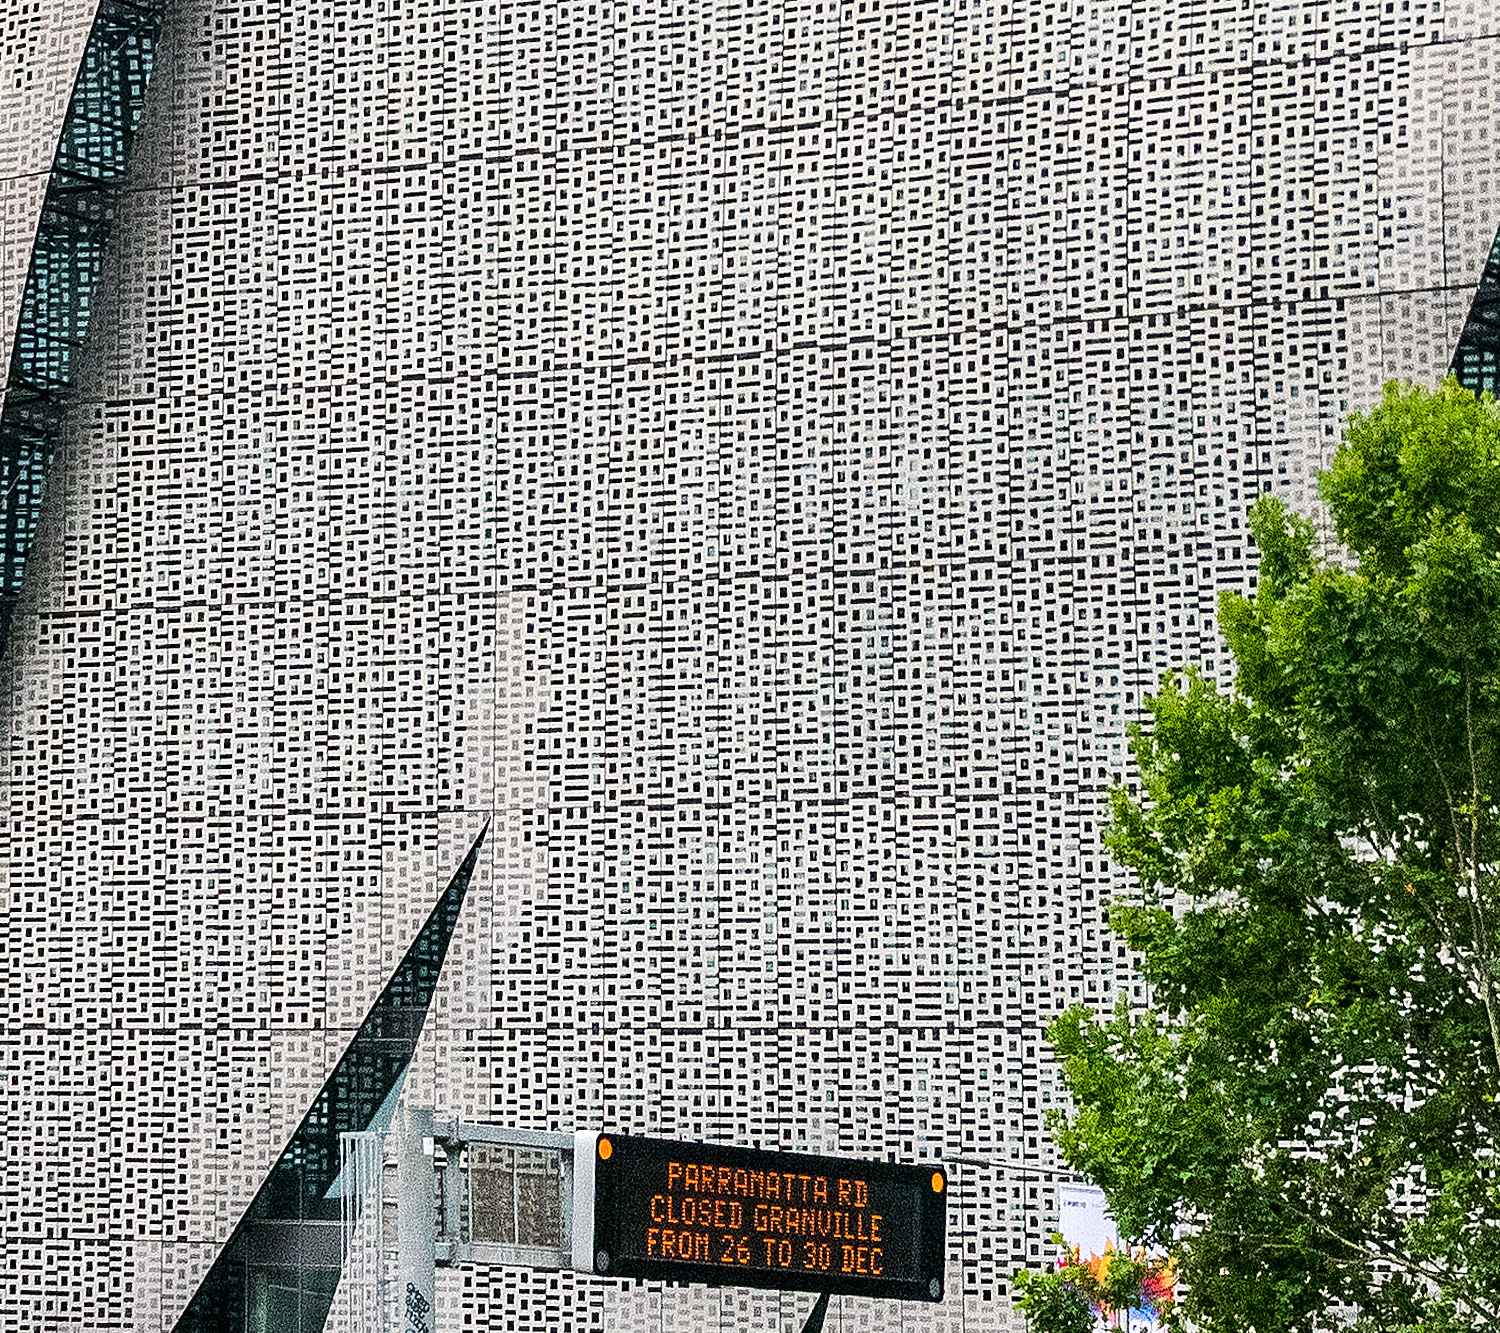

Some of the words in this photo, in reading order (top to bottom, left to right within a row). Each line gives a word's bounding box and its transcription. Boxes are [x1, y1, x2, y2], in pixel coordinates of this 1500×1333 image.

[668, 1162, 827, 1204] PARRAMATTA
[838, 1179, 868, 1208] RD
[651, 1195, 743, 1230] CLOSED
[754, 1204, 882, 1241] GRANVILLE
[647, 1228, 709, 1261] FROM
[721, 1235, 750, 1264] 26
[763, 1238, 792, 1268] TO
[803, 1242, 831, 1271] 30
[842, 1245, 883, 1275] DEC
